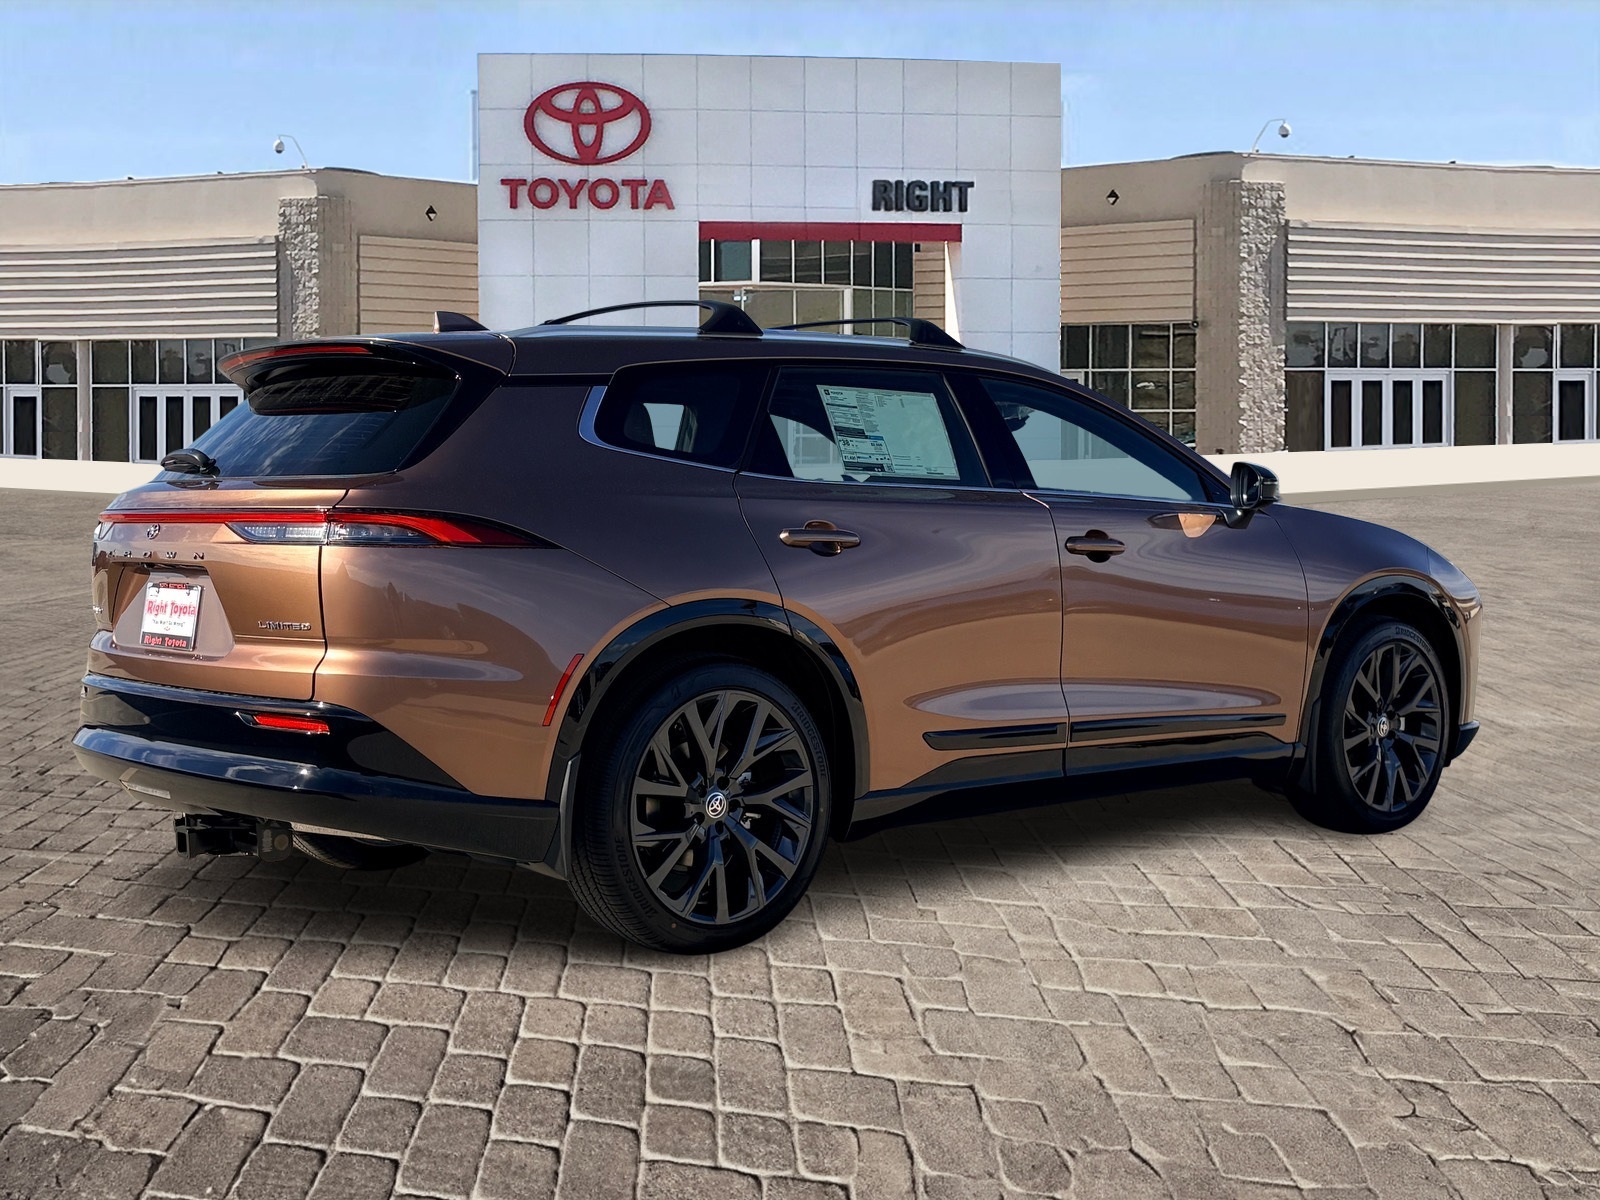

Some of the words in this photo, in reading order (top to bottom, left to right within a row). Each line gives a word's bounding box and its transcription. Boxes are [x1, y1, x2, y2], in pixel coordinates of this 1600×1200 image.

[500, 179, 675, 210] TOYOTA
[871, 180, 975, 213] RIGHT
[147, 600, 168, 616] Right
[170, 602, 197, 618] Toyota
[144, 634, 162, 646] Right
[165, 637, 187, 648] Toyota
[257, 620, 312, 631] LIMITED
[790, 701, 828, 778] BRIDGESTONE
[613, 835, 660, 919] BRIDGESTONE
